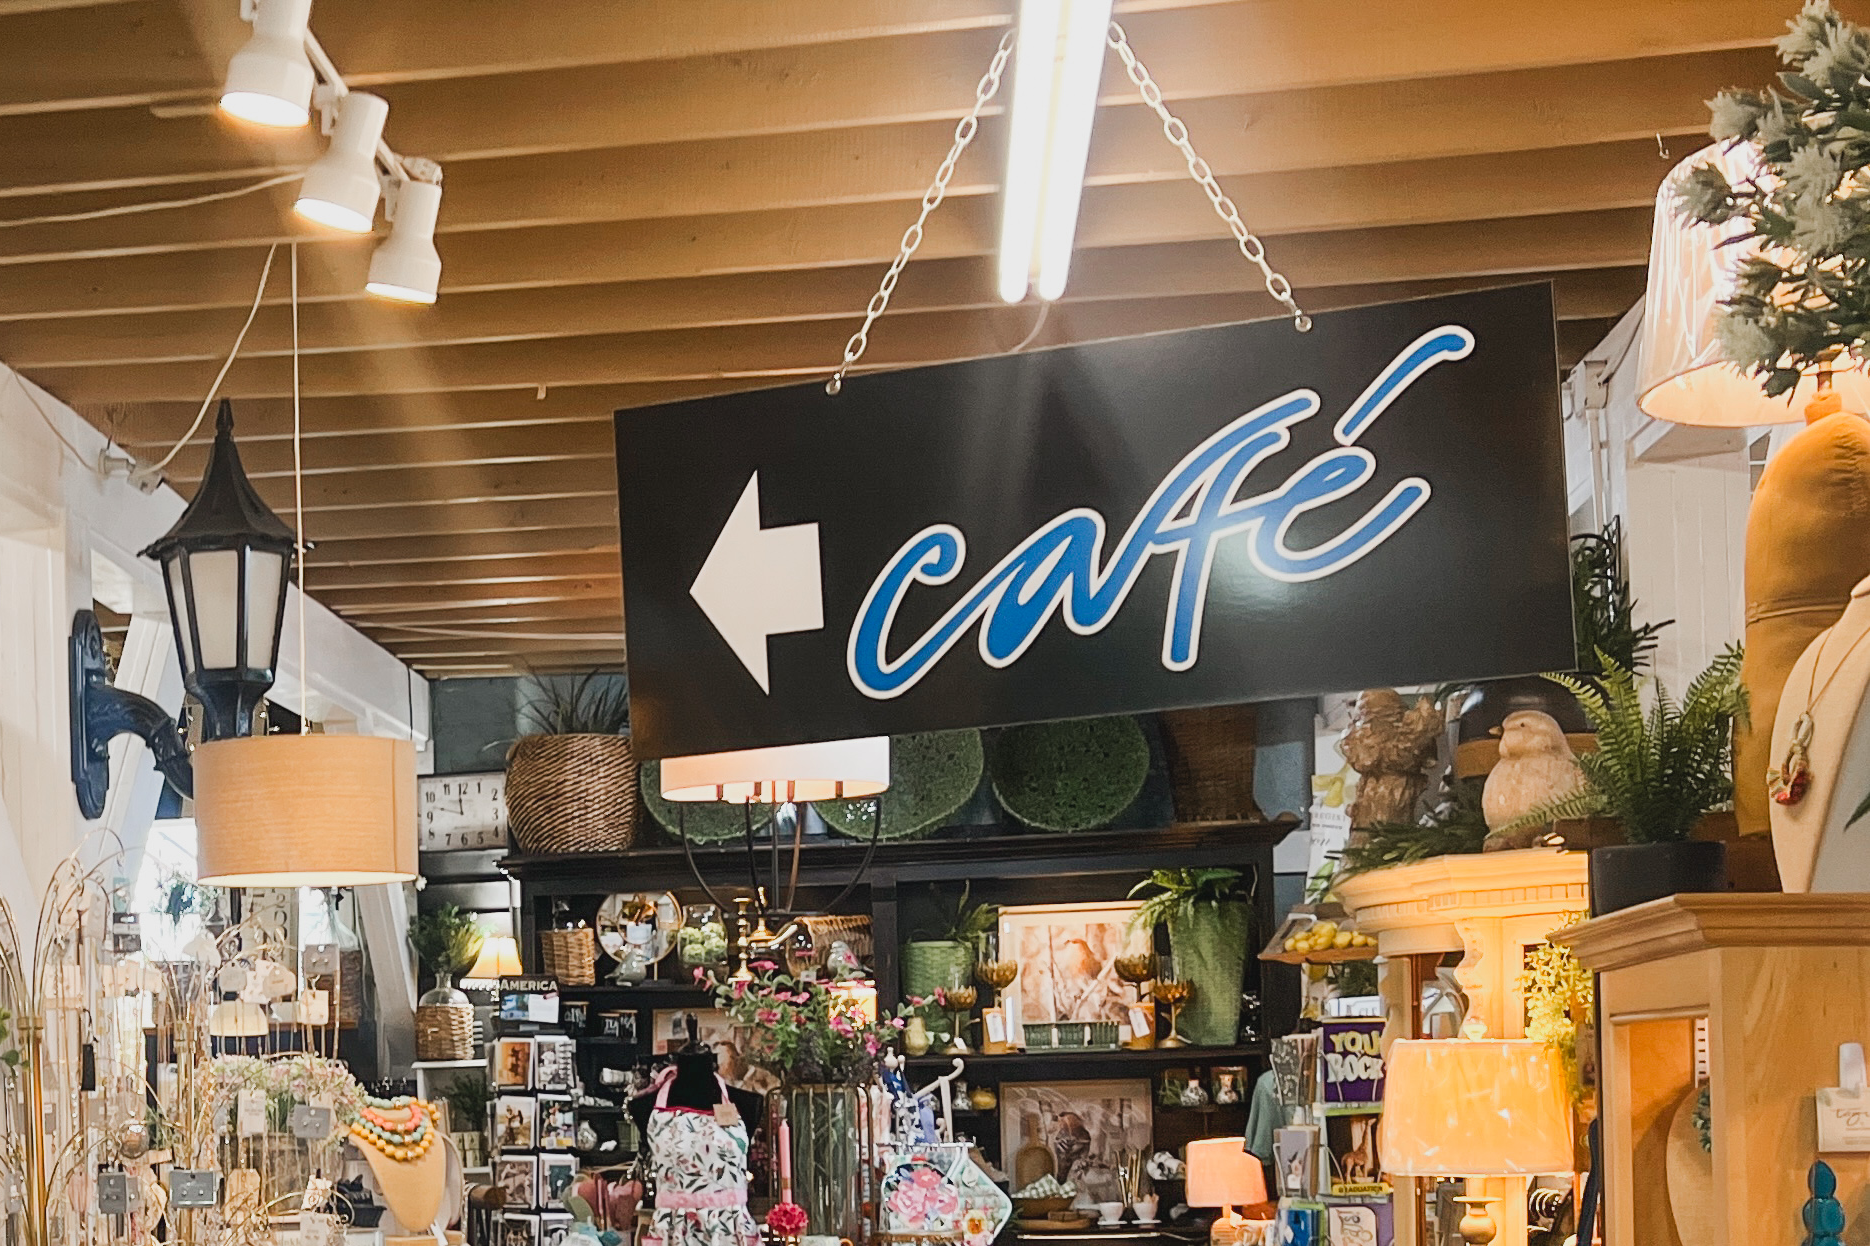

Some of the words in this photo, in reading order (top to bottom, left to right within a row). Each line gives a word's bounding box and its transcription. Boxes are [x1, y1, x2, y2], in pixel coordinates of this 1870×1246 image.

[846, 323, 1476, 700] café
[1329, 1031, 1380, 1056] YOU
[1325, 1053, 1384, 1083] ROCK
